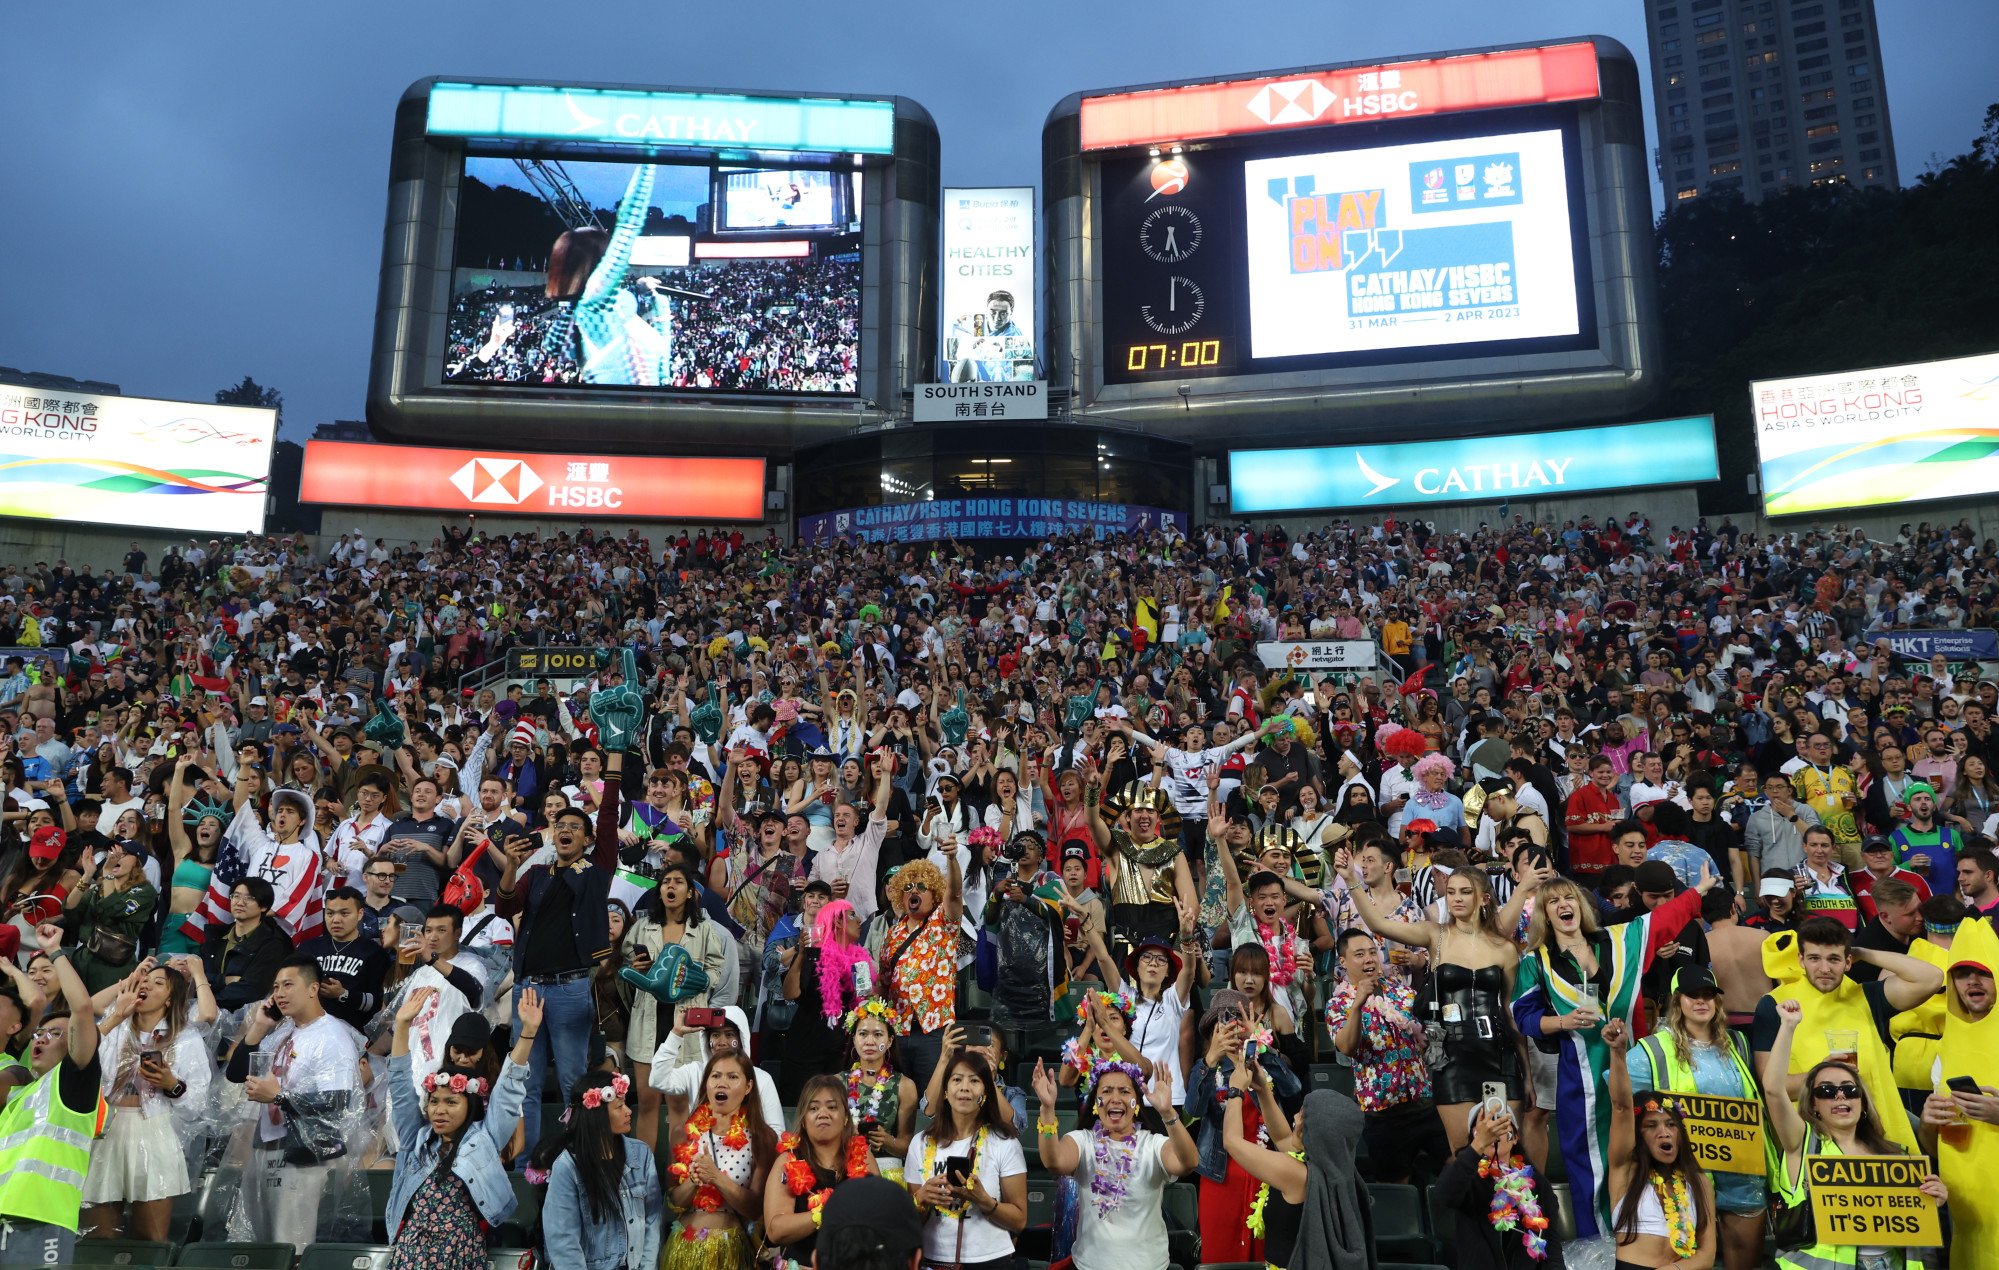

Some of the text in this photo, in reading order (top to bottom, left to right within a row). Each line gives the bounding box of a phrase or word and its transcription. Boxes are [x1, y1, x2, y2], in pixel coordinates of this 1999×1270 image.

[1342, 90, 1418, 118] HSBC
[615, 112, 758, 143] CATHAY
[973, 200, 999, 209] Bupa
[1292, 190, 1382, 235] PLAY
[949, 245, 1030, 259] HEALTHY
[1292, 231, 1343, 273] ON
[958, 263, 1014, 277] CITIES
[1350, 262, 1512, 298] CATHAY/HSBC
[1351, 284, 1513, 315] HONG KONG SEVENS
[1348, 307, 1521, 330] 31 MAR 2 APR 2023
[1127, 339, 1220, 371] 07:00
[924, 384, 1037, 400] SOUTH STAND
[954, 402, 1007, 418] 南看台
[1760, 388, 1923, 421] HONG KONG
[24, 411, 99, 432] KONG
[1763, 405, 1924, 432] ASIA'S WORLD CITY
[58, 430, 96, 443] CITY
[1413, 457, 1573, 495] CATHAY
[548, 485, 623, 509] HSBC
[855, 499, 1127, 526] CATHAY/HSBC HONG KONG SEVENS
[1890, 637, 1931, 653] HKT
[1933, 637, 1974, 645] Enterprise
[1934, 645, 1971, 653] Solutions
[543, 654, 586, 669] 1010
[1311, 656, 1345, 664] netvigator
[1810, 899, 1838, 909] SOUTH
[1677, 1096, 1757, 1123] AUTION
[1690, 1124, 1756, 1142] PROBABLY
[1811, 1161, 1926, 1185] CAUTION
[1822, 1194, 1927, 1211] IT'S NOT BEER,
[1829, 1214, 1921, 1234] IT'S PISS
